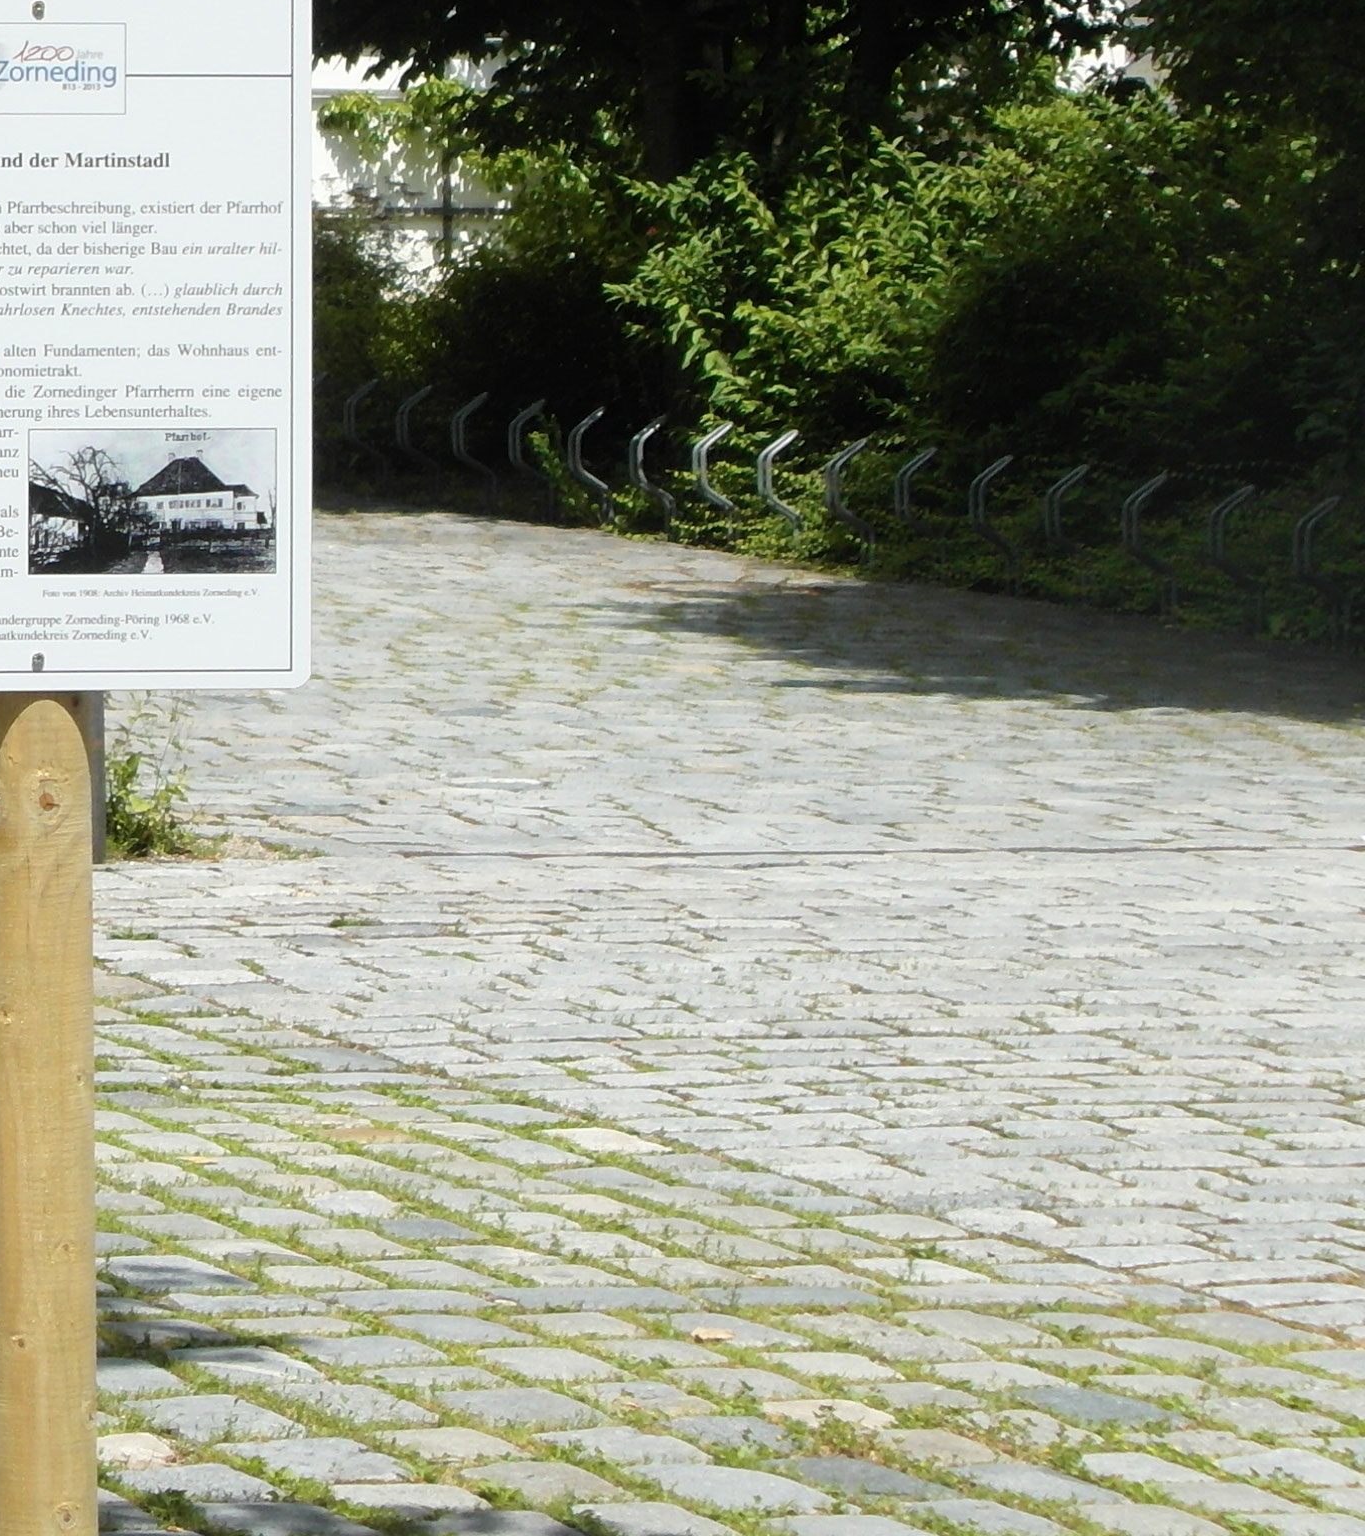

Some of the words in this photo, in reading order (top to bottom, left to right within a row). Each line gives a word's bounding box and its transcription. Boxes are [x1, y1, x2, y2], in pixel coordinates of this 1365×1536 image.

[12, 40, 75, 62] 1200
[28, 152, 60, 169] der
[64, 152, 170, 168] Martinstadl
[7, 200, 136, 218] Pfarrbeschreibung,
[139, 200, 196, 215] existiert
[199, 200, 223, 215] der
[226, 200, 285, 215] Pfarrhof
[3, 220, 35, 235] aber
[37, 220, 77, 235] schon
[81, 220, 107, 235] viel
[111, 220, 158, 238] länger.
[35, 241, 53, 256] da
[56, 241, 80, 256] der
[83, 241, 146, 259] bisherige
[150, 241, 178, 256] Bau
[181, 242, 203, 256] ein
[207, 241, 256, 256] uralter
[6, 265, 24, 277] zu
[26, 262, 101, 279] reparieren
[104, 265, 135, 276] war.
[50, 282, 112, 297] brannten
[115, 282, 136, 297] ab.
[173, 282, 239, 300] glaublich
[242, 282, 283, 297] durch
[60, 302, 126, 318] Knechtes,
[131, 302, 221, 316] entstehenden
[225, 302, 284, 316] Brandes
[3, 343, 37, 358] alten
[43, 343, 141, 359] Fundamenten;
[146, 343, 171, 357] das
[176, 343, 250, 357] Wohnhaus
[255, 345, 283, 357] ent-
[4, 384, 26, 399] die
[32, 384, 119, 402] Zornedinger
[125, 384, 195, 398] Pfarrherrn
[201, 384, 231, 398] eine
[237, 384, 283, 402] eigene
[47, 404, 81, 419] ihres
[84, 404, 212, 419] Lebensunterhaltes.
[0, 504, 20, 519] als
[164, 613, 191, 625] 1968
